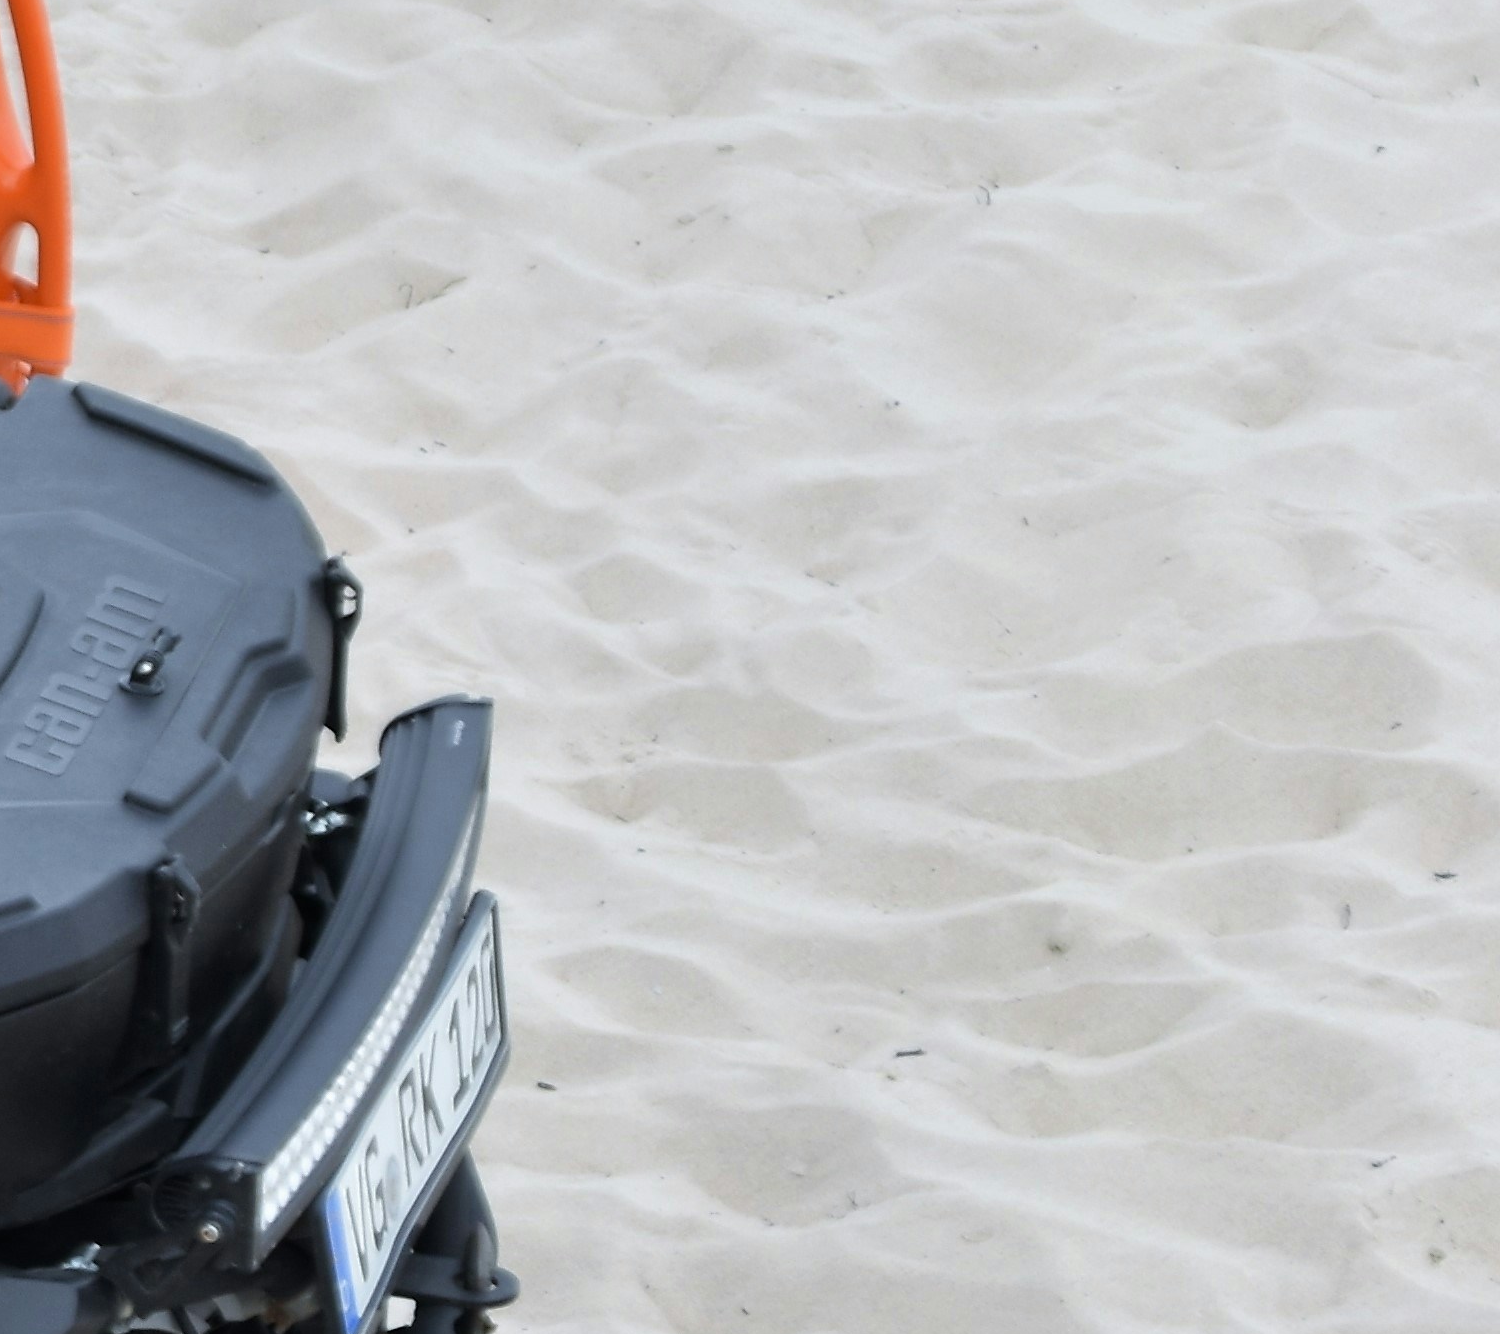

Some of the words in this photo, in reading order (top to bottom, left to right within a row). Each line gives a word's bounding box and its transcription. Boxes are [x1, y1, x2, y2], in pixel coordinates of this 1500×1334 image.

[4, 574, 169, 779] can-am
[345, 1134, 388, 1284] VG
[398, 1030, 445, 1187] RK
[448, 931, 498, 1111] 120
